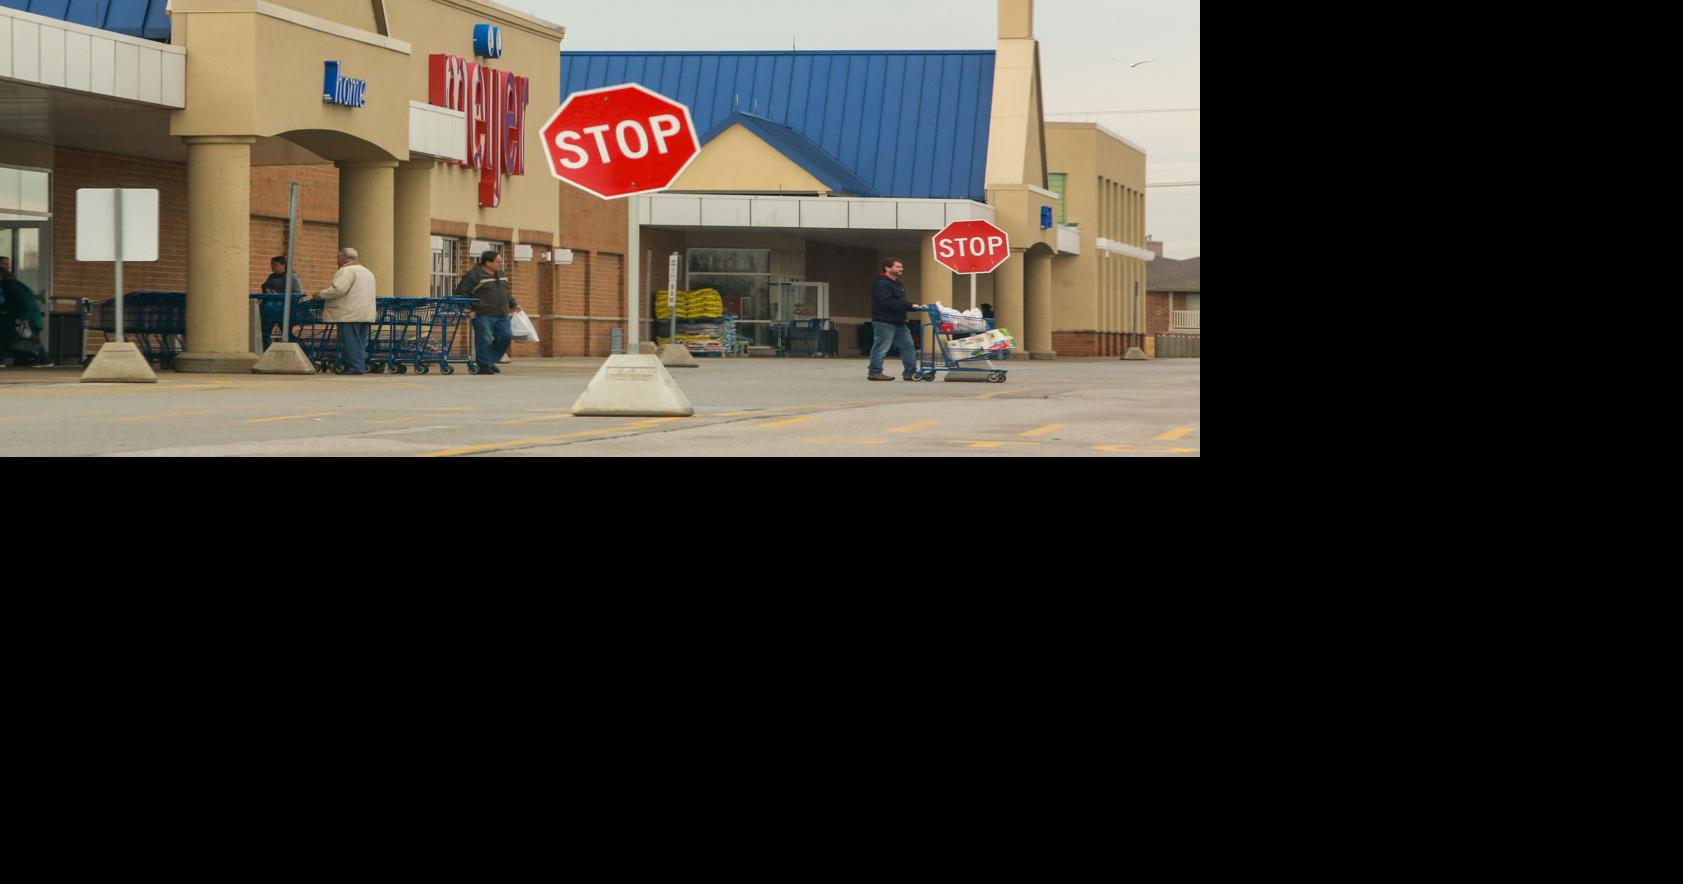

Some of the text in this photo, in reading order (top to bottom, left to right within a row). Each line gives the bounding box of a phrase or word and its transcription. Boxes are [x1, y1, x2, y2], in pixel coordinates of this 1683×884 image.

[323, 60, 366, 107] home
[429, 24, 529, 208] meijer
[555, 114, 681, 169] STOP
[939, 236, 1003, 258] STOP
